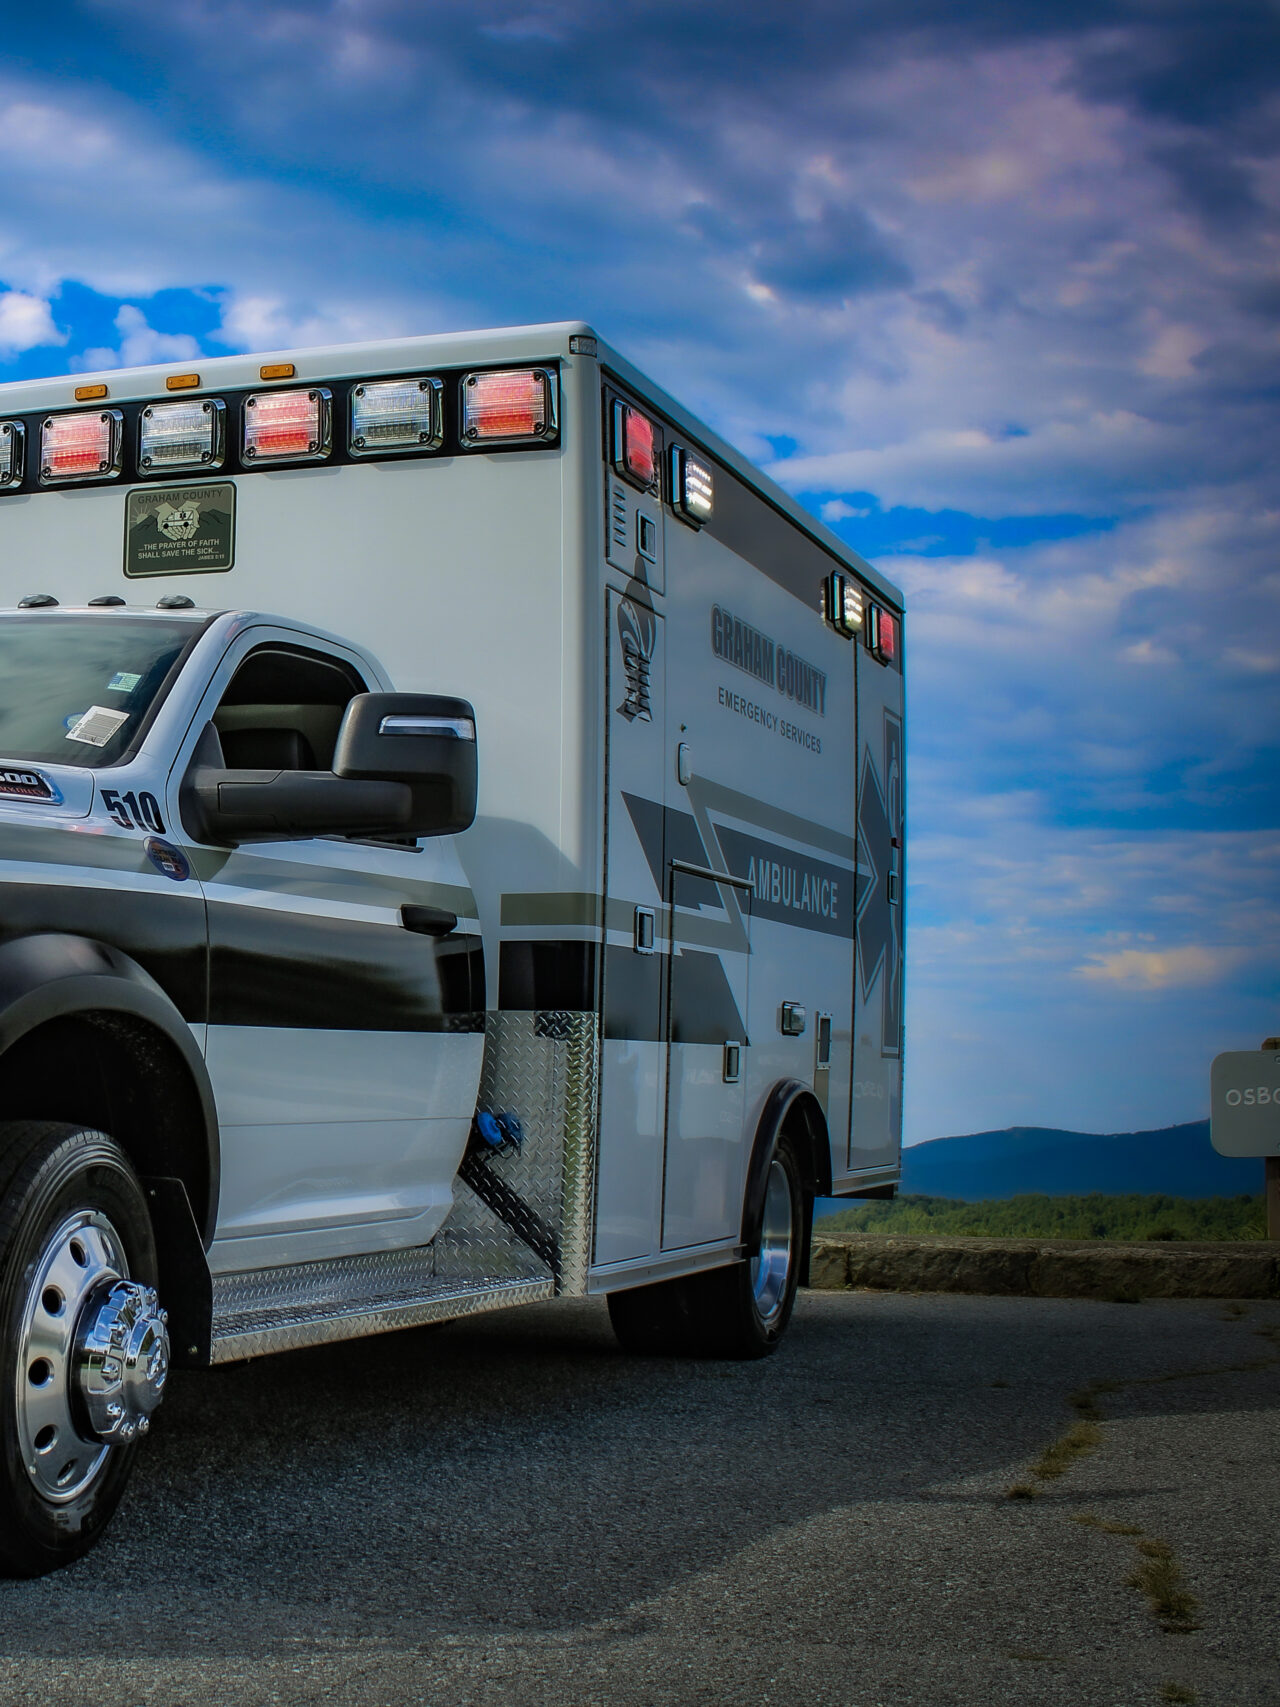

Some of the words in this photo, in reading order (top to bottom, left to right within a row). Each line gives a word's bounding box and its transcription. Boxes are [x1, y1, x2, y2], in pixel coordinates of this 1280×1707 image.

[138, 492, 180, 504] GRAHAM
[183, 489, 223, 500] COUNTY
[138, 552, 160, 560] SHALL
[161, 549, 180, 558] SAVE
[181, 548, 195, 556] THE
[159, 541, 186, 550] PRAYER
[199, 538, 220, 547] FAITH
[711, 603, 775, 689] GRAHAM
[776, 644, 827, 718] COUNTY
[718, 686, 778, 732] EMERGENCY
[780, 719, 822, 754] SERVICES
[100, 789, 167, 834] 510
[745, 855, 838, 919] AMBULANCE
